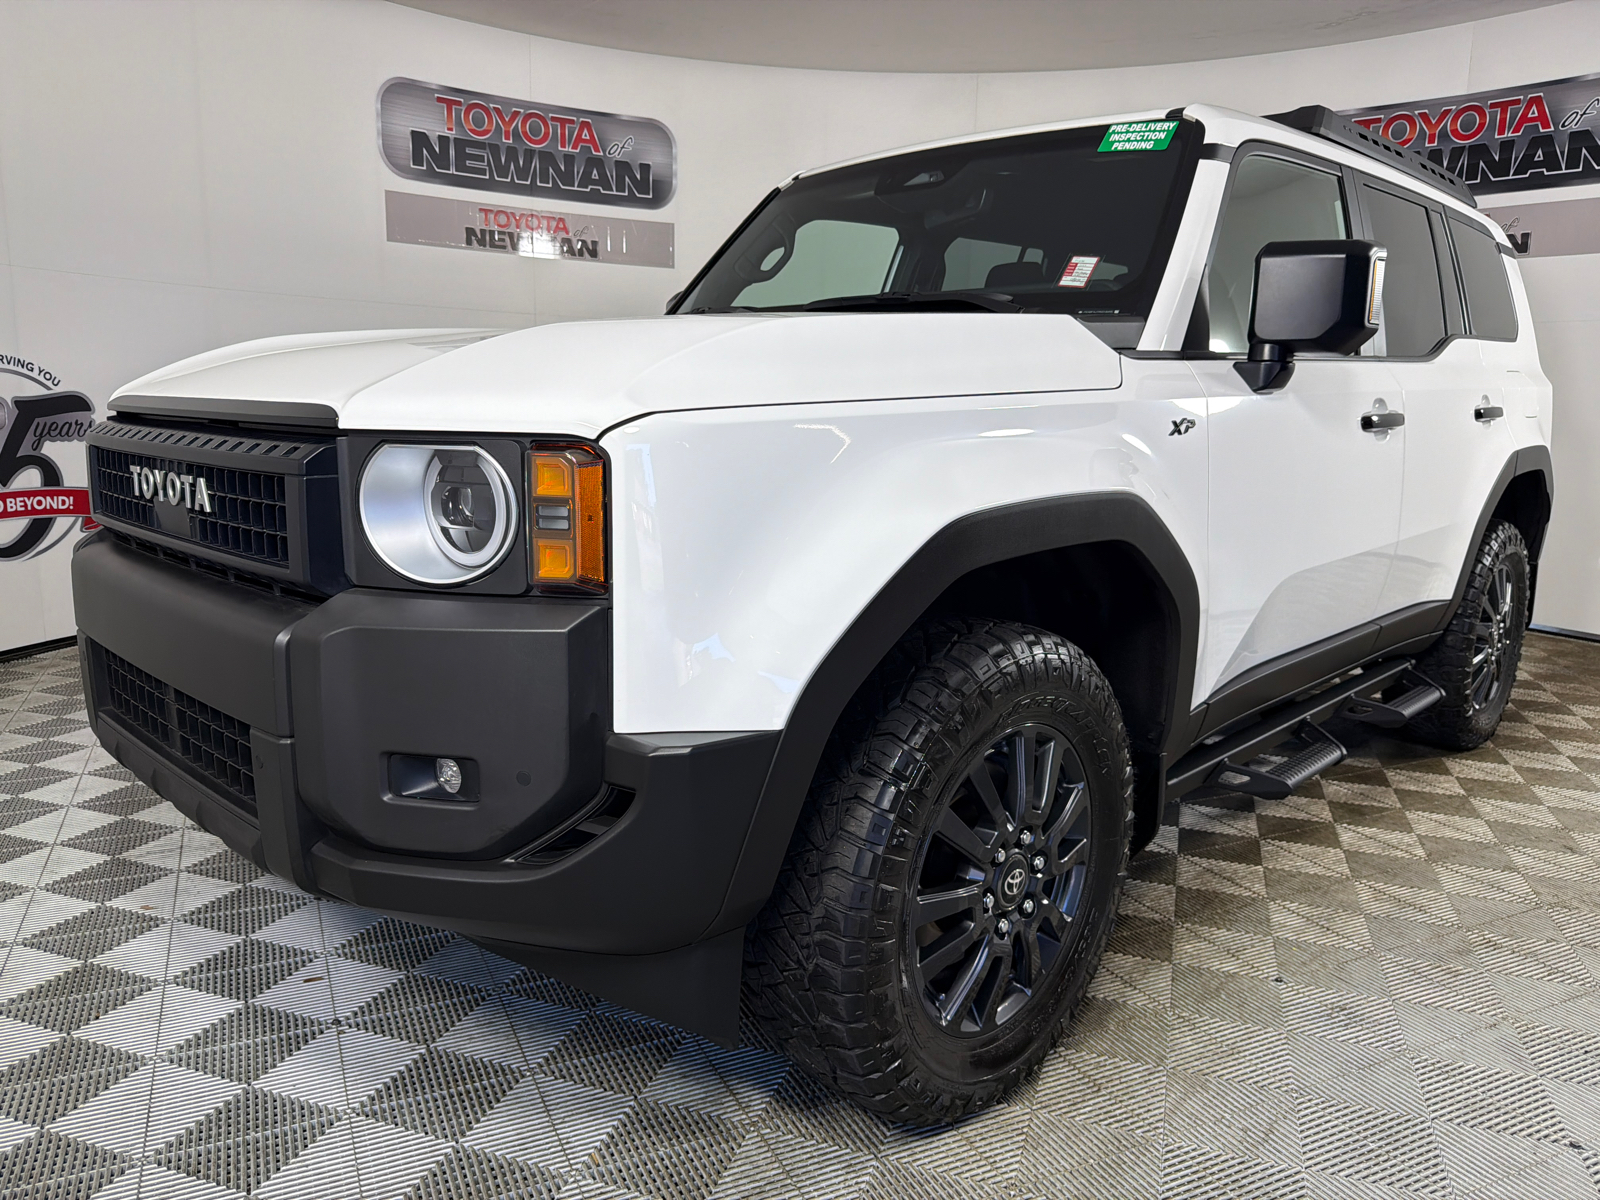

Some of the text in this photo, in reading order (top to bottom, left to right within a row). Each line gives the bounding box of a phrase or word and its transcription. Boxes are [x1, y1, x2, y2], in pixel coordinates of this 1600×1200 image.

[1559, 97, 1600, 130] of
[435, 94, 634, 158] TOYOTA of
[1109, 122, 1177, 133] PRE-DELIVERY
[1109, 132, 1167, 142] INSPECTION
[1111, 141, 1154, 150] PENDING
[410, 128, 652, 198] NEWNAN
[479, 208, 589, 238] TOYOTA of
[38, 366, 61, 387] YOU
[1168, 417, 1196, 436] XP
[130, 465, 212, 512] TOYOTA
[6, 496, 74, 512] BEYOND!
